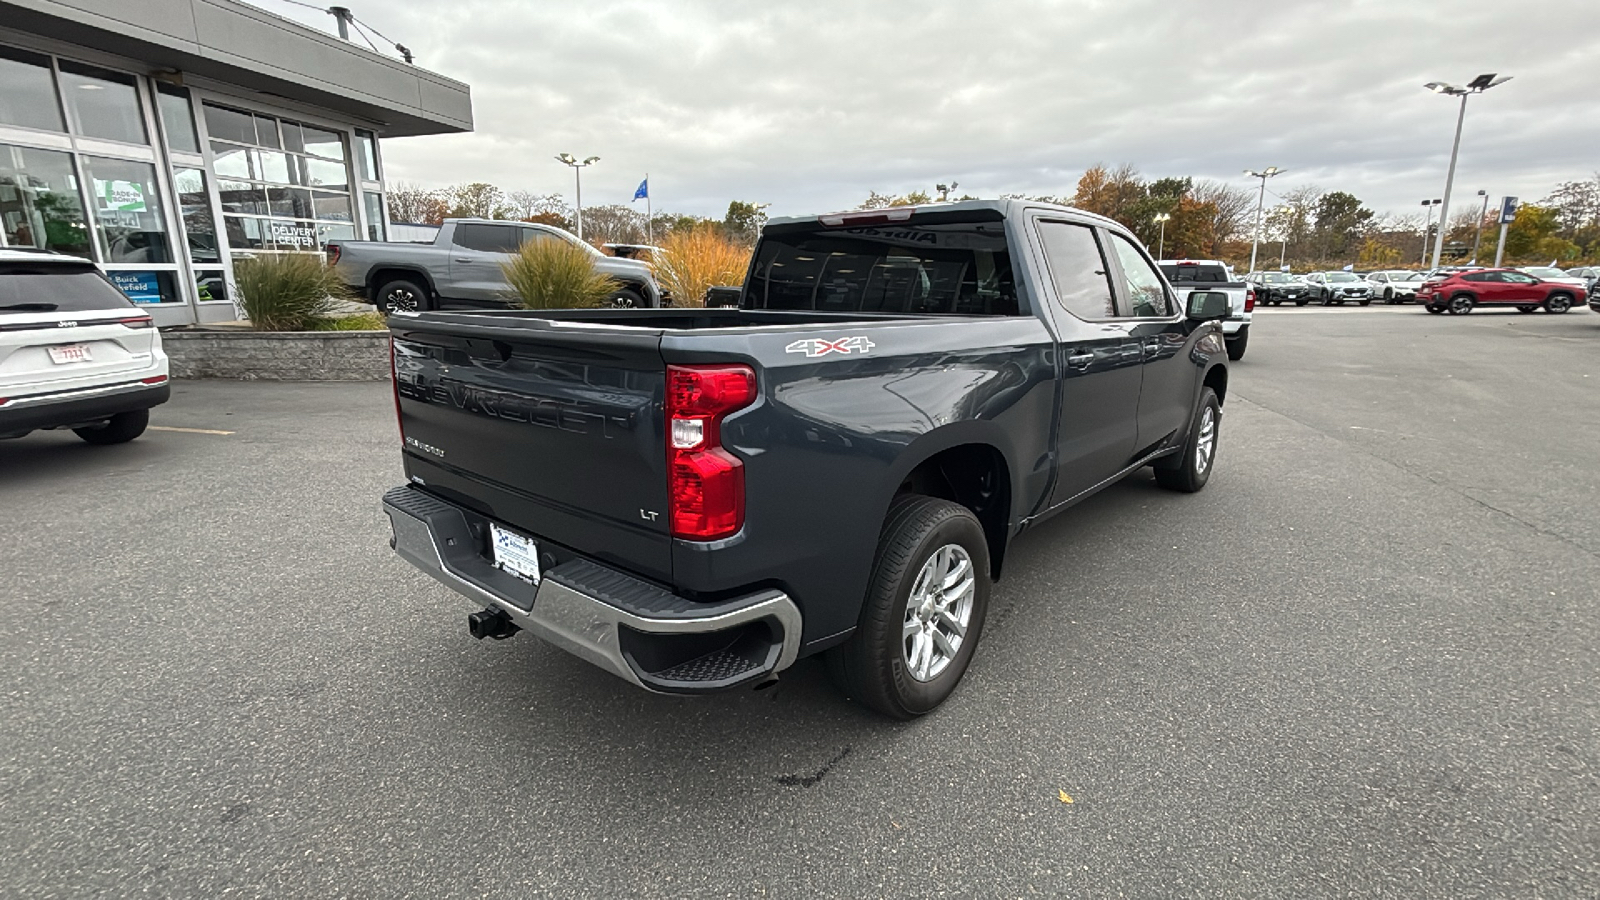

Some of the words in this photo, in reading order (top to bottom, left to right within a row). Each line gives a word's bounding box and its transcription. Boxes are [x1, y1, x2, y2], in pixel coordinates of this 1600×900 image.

[272, 226, 316, 236] DELIVERY
[278, 236, 314, 247] CENTER
[640, 508, 659, 522] LT
